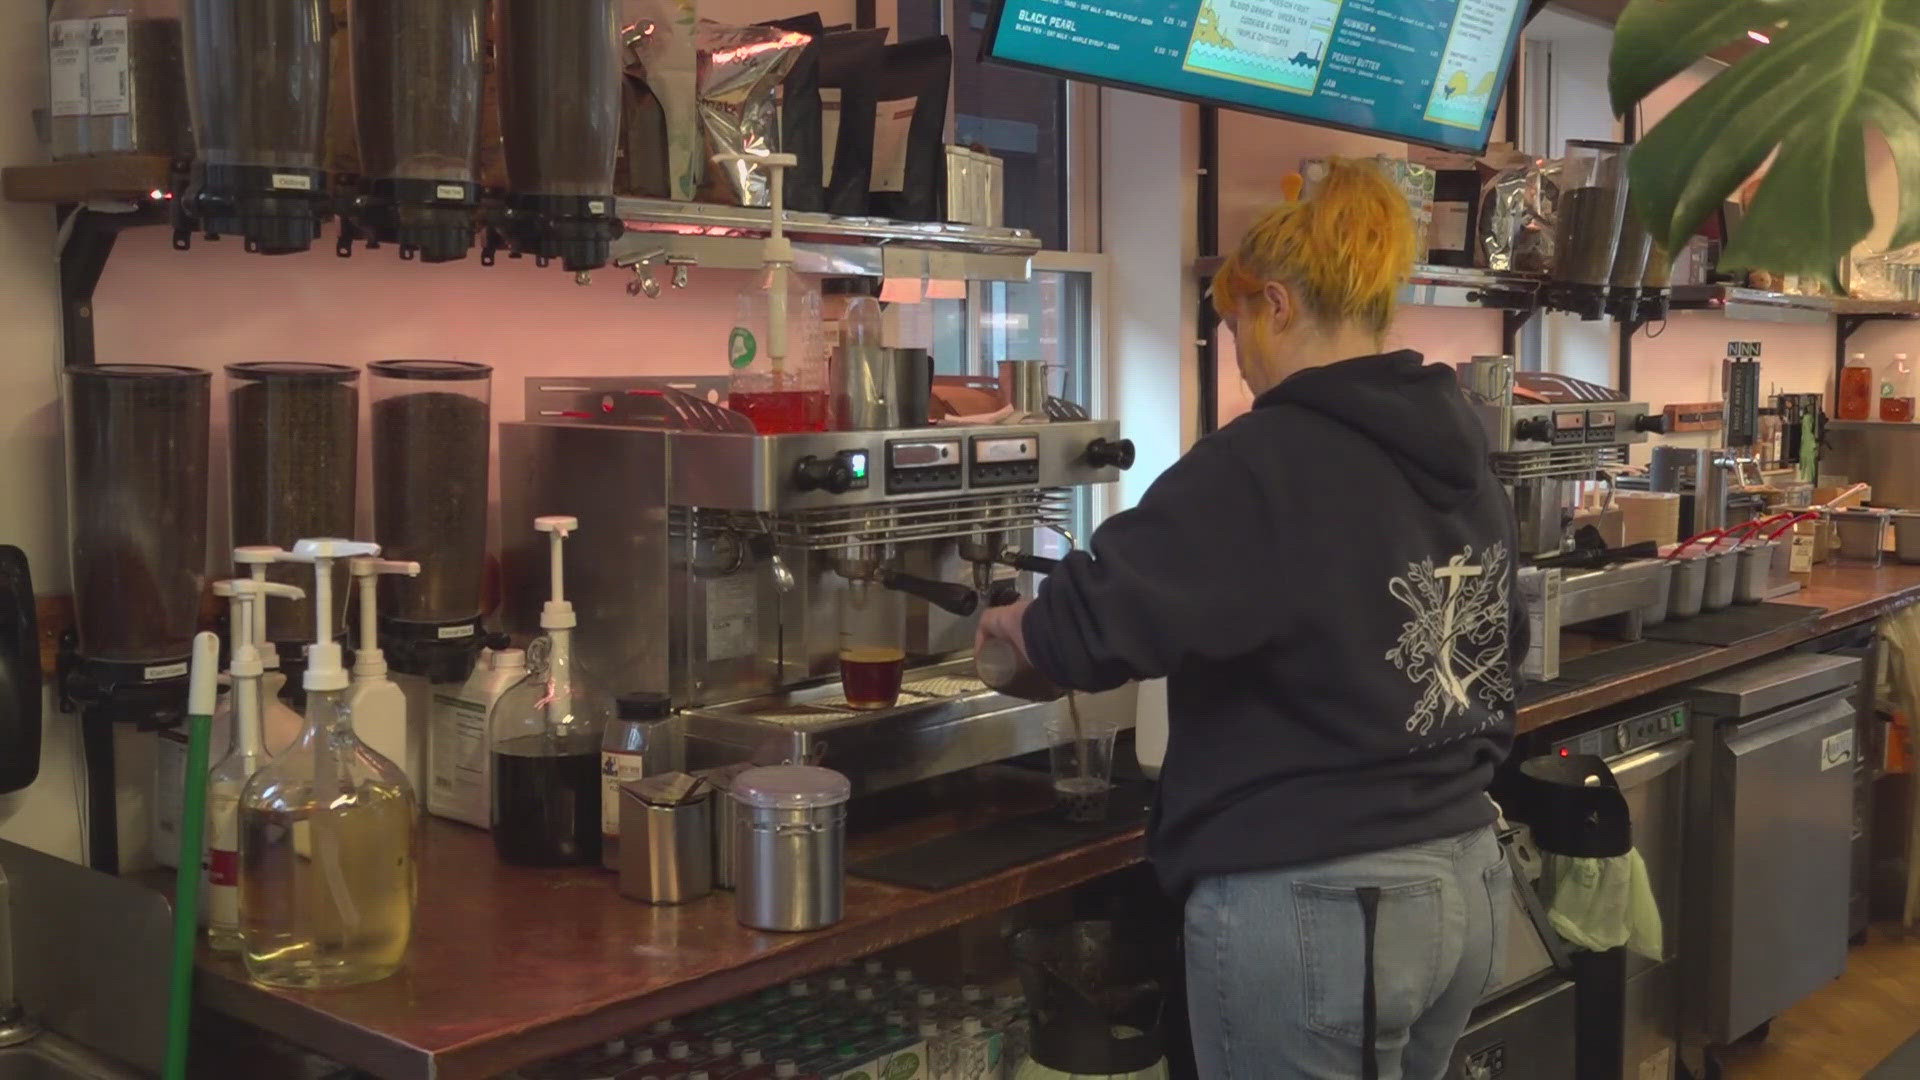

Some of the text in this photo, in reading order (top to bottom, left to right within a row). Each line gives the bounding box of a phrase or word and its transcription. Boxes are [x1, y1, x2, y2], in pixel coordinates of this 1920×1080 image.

[1015, 23, 1032, 33] BLACK
[1018, 10, 1077, 31] BLACK PEARL
[1332, 52, 1381, 71] PEANUT BUTTER
[1322, 78, 1337, 89] JAM
